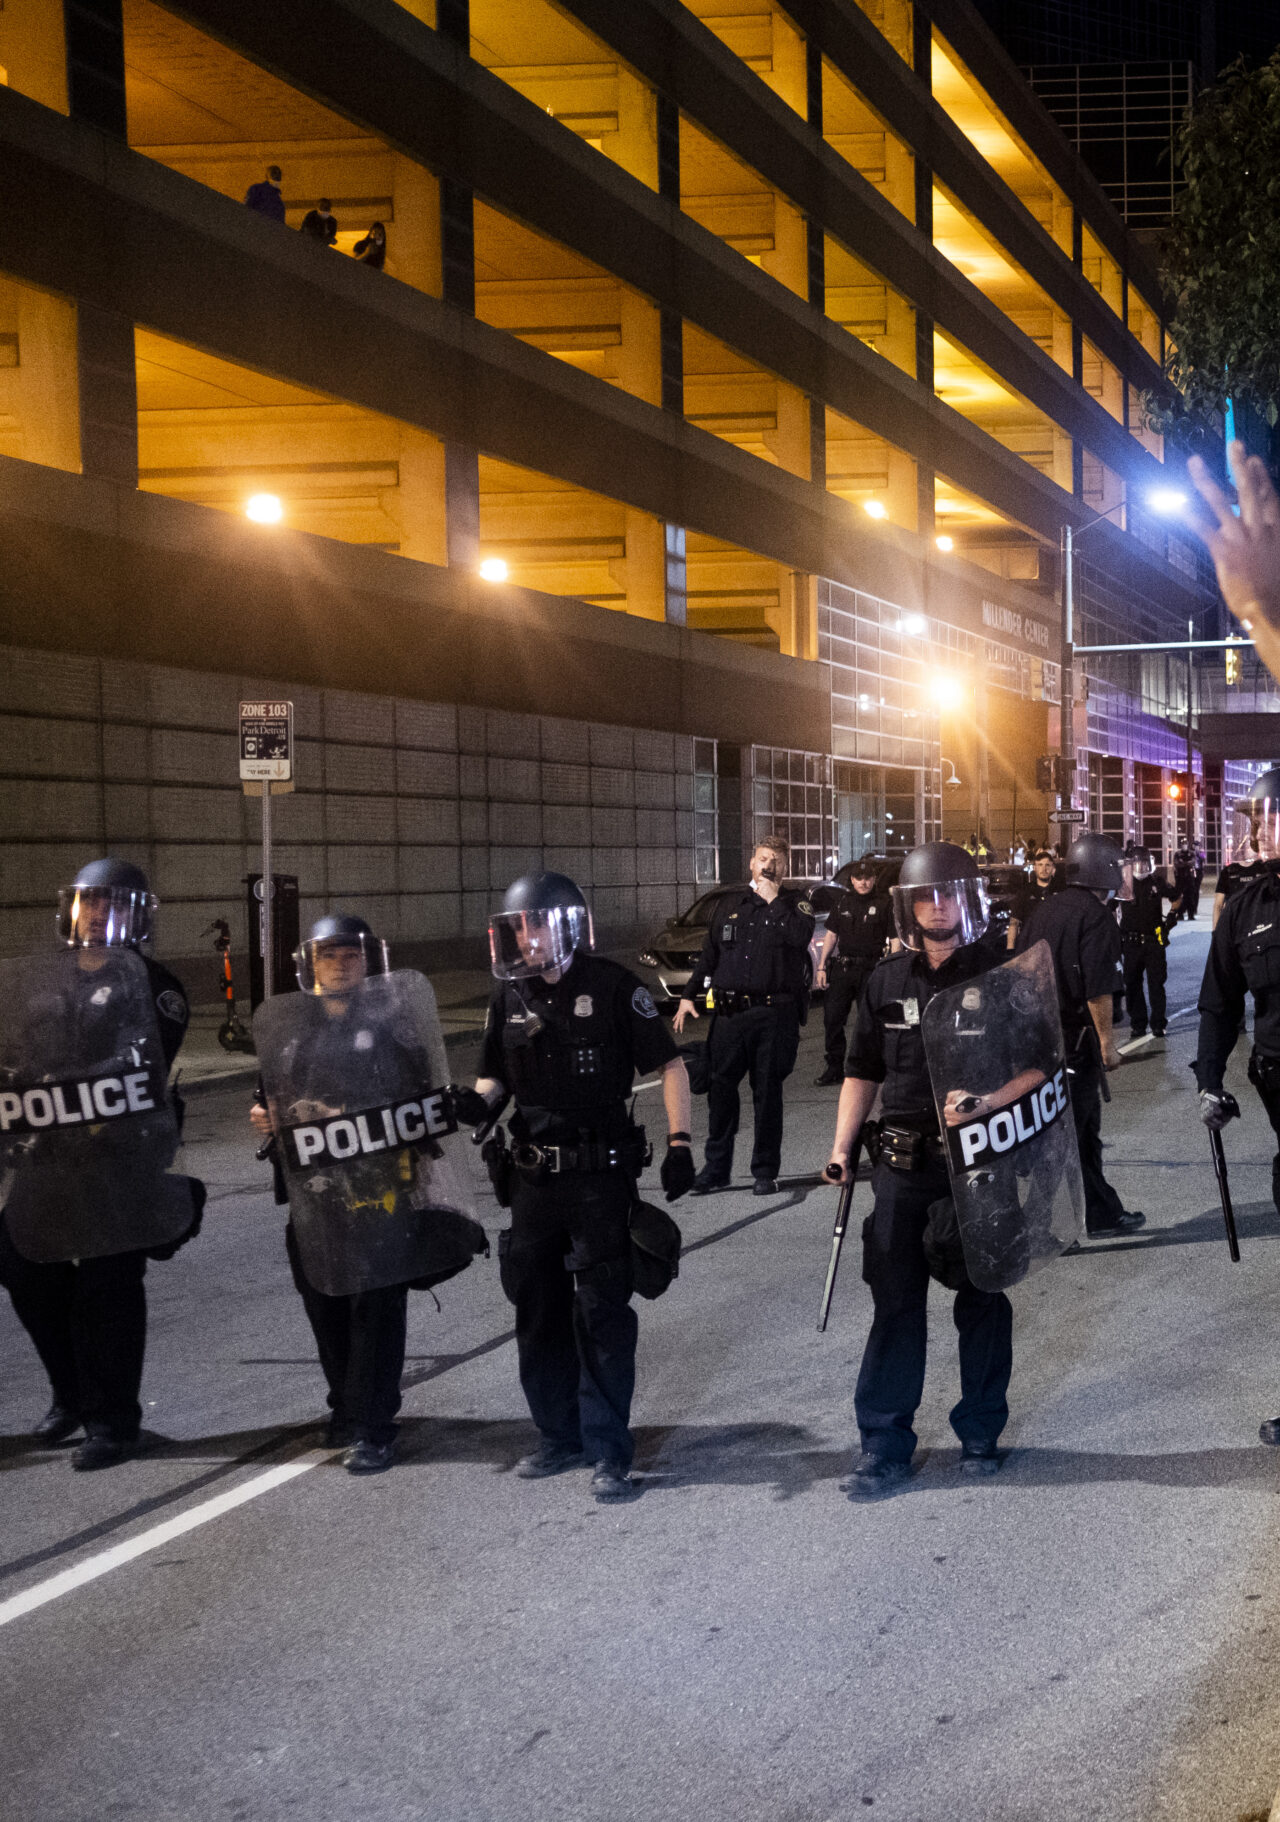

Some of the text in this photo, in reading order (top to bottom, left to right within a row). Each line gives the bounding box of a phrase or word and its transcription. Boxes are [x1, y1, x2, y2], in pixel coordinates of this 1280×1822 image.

[1024, 618, 1049, 649] CENTER
[242, 704, 287, 717] ZONE 103
[242, 726, 286, 735] Park Detroit
[0, 1072, 155, 1130] POLICE
[959, 1068, 1067, 1167] POLICE
[293, 1094, 449, 1166] POLICE
